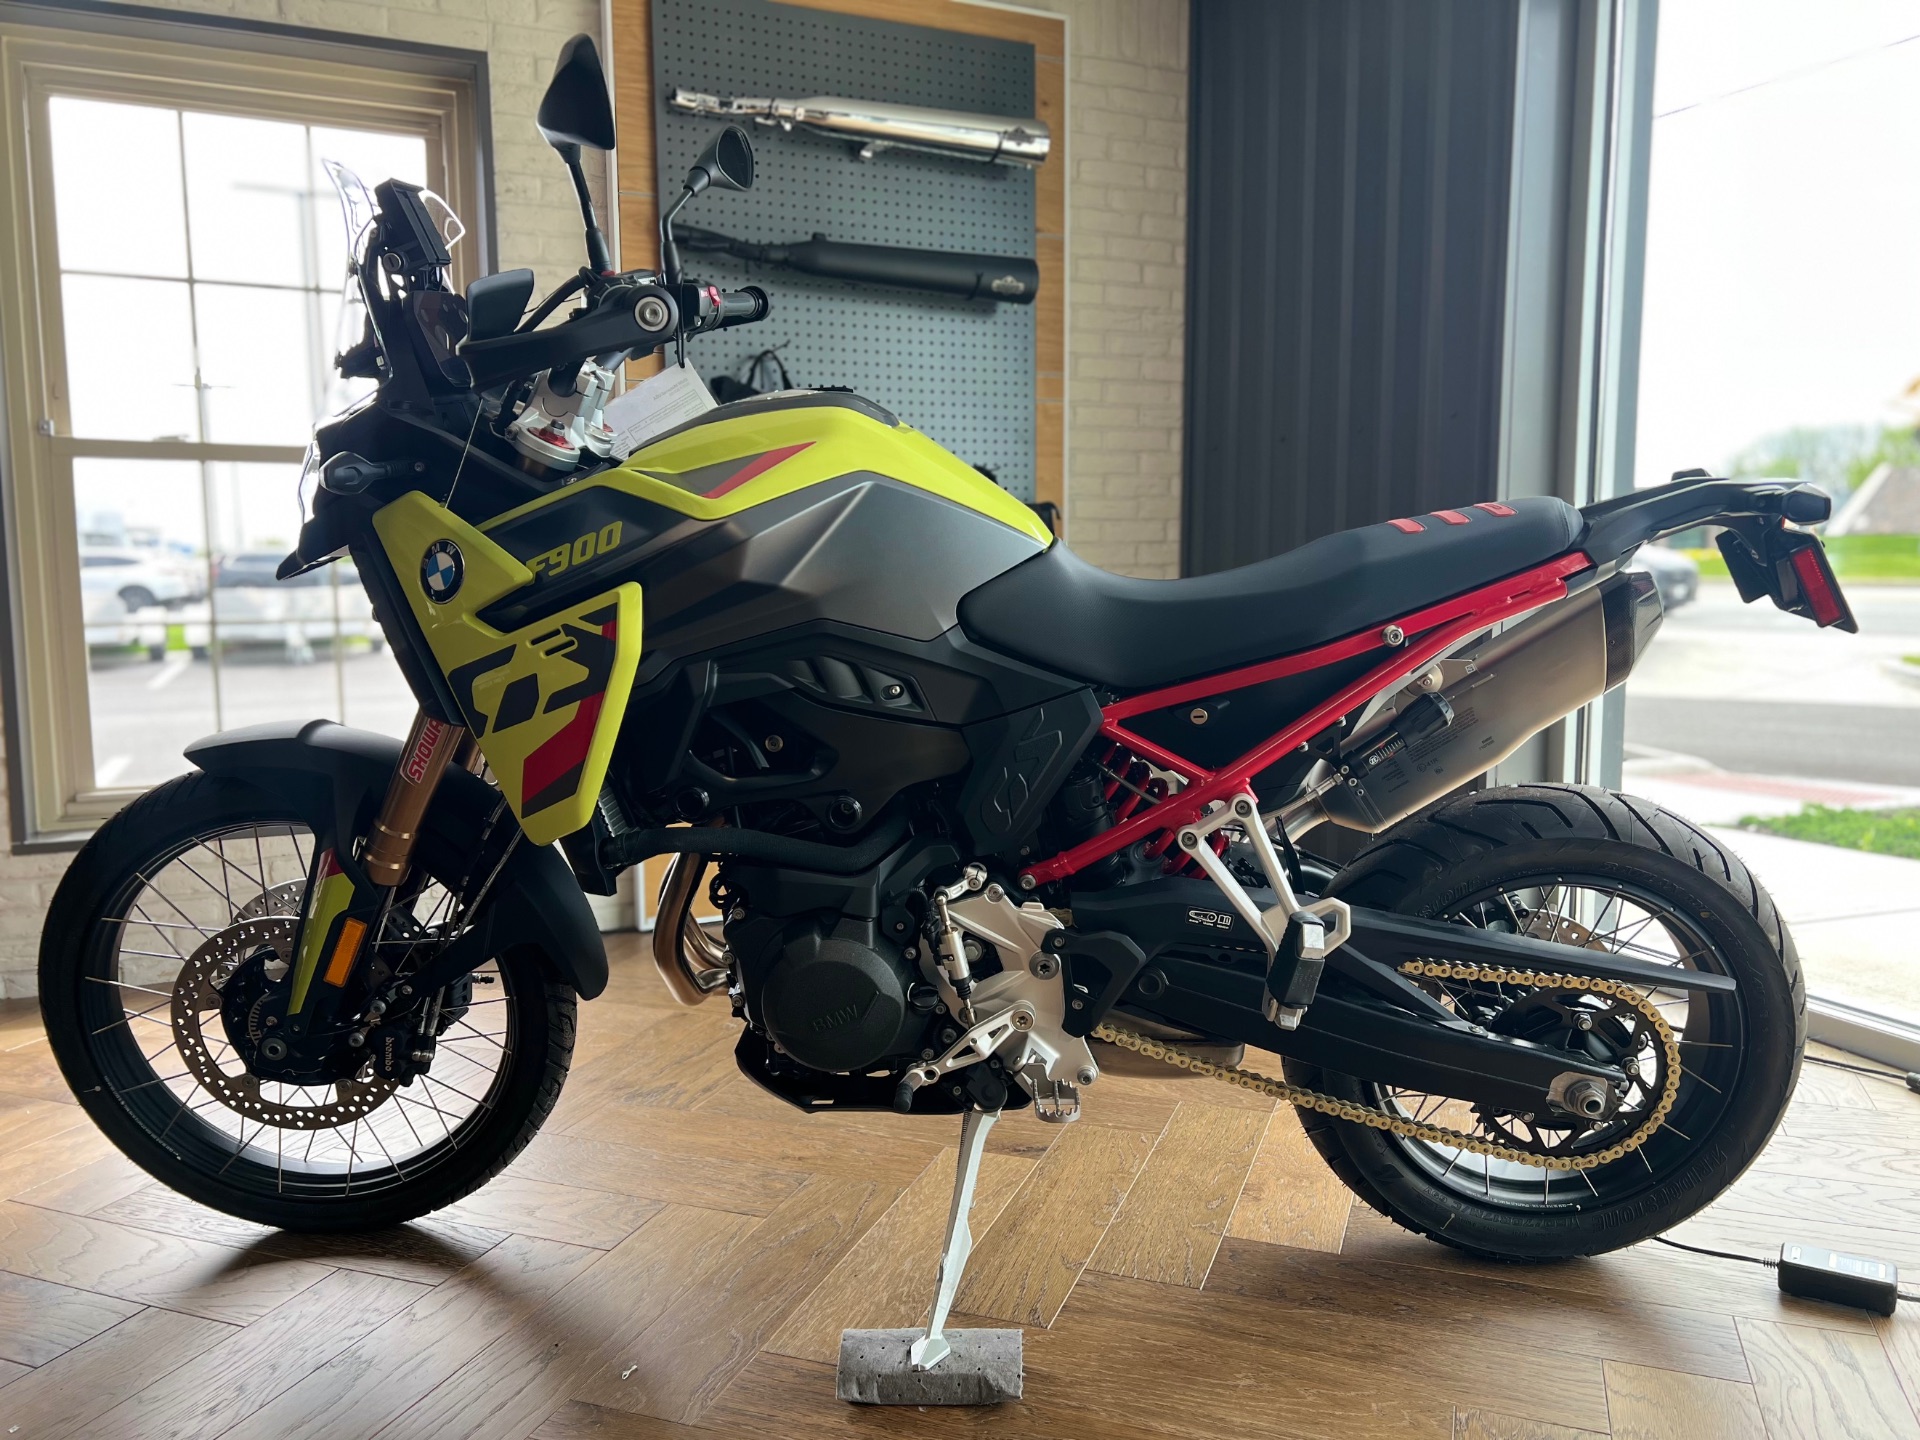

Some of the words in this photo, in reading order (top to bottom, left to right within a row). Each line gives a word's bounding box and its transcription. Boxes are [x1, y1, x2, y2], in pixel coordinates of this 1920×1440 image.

[525, 521, 623, 584] F900
[407, 717, 445, 784] SHOWA
[813, 1003, 858, 1031] BMW
[385, 1036, 395, 1072] brembo
[1592, 1143, 1727, 1233] BRIDGESTONE
